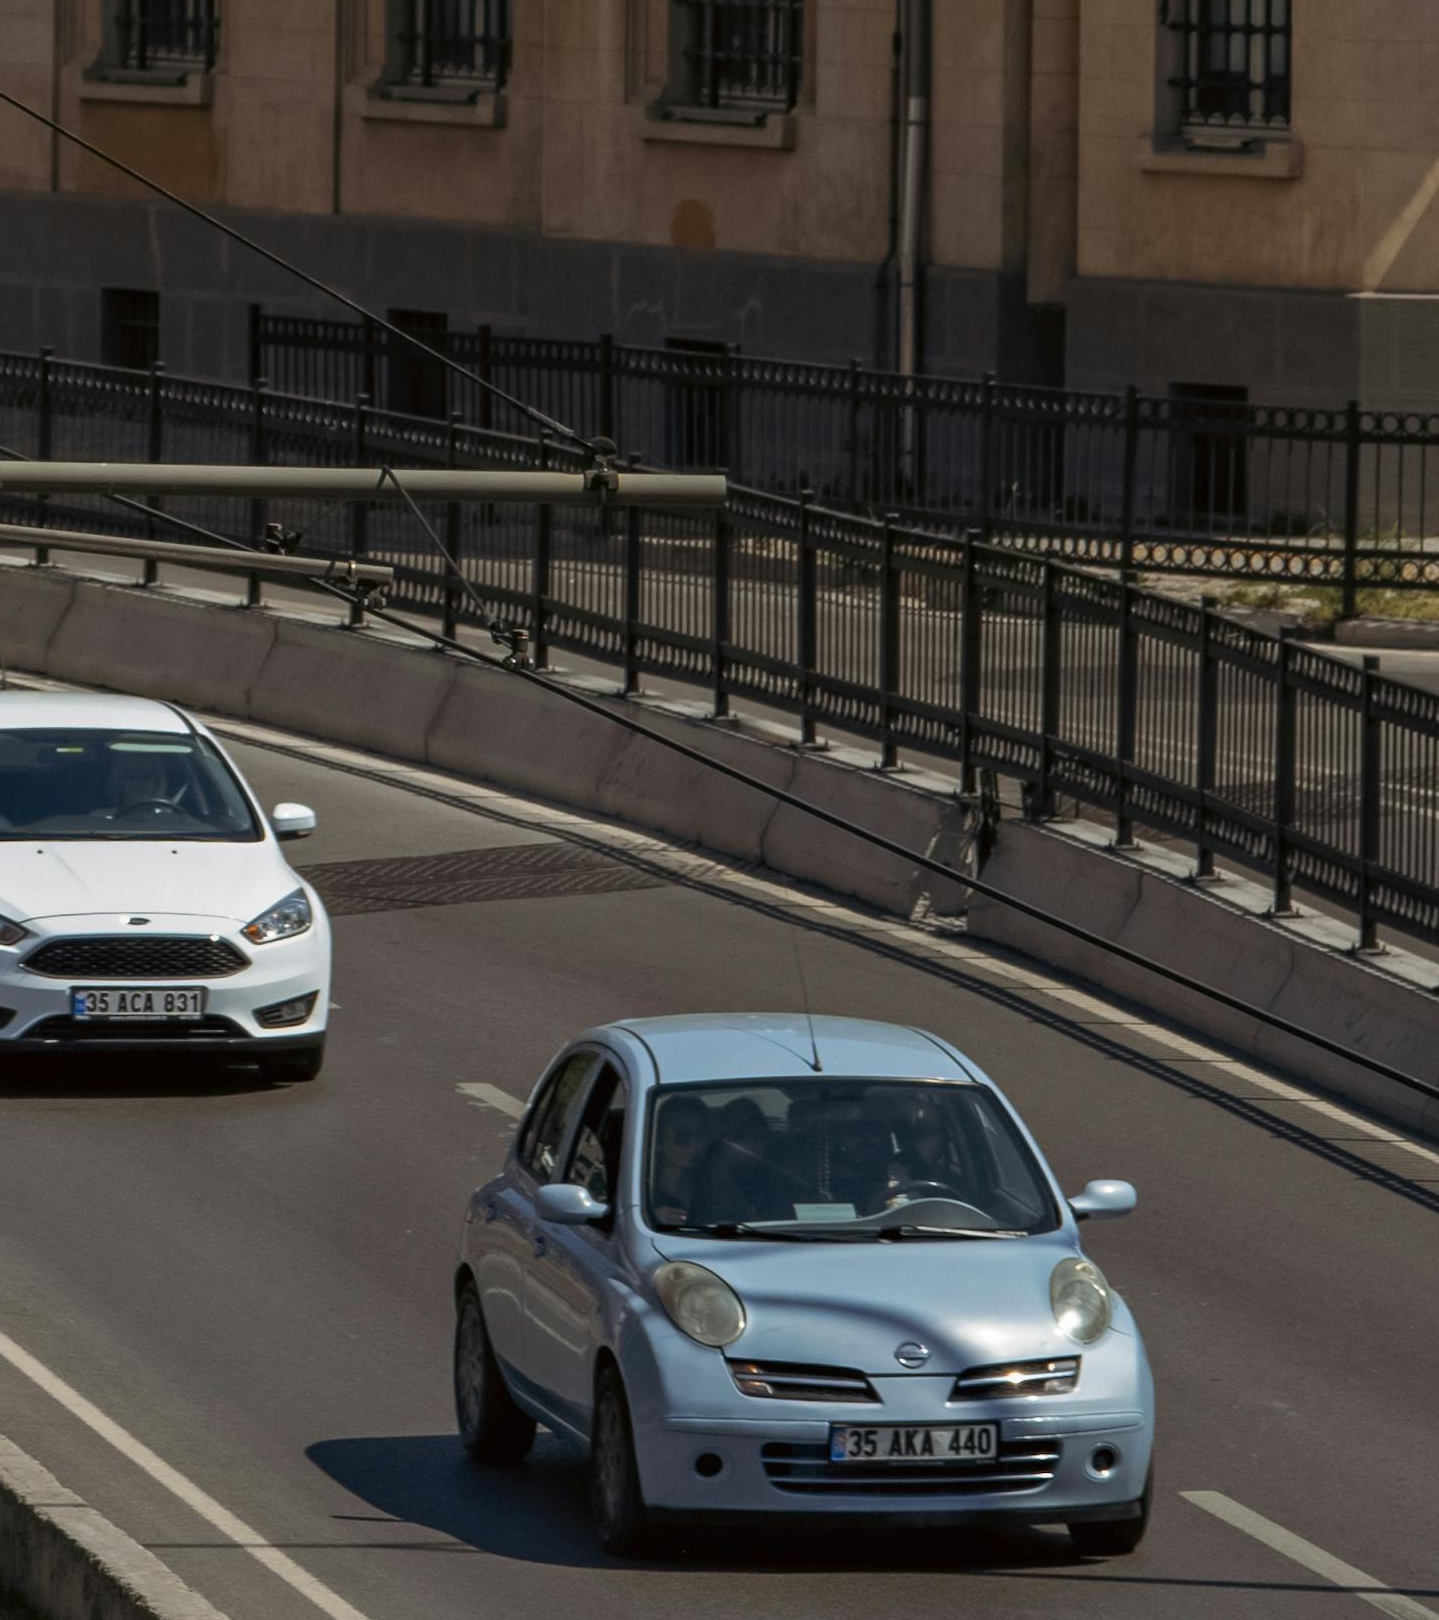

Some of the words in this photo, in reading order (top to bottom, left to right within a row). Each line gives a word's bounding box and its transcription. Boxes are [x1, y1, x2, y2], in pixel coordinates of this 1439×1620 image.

[86, 993, 109, 1013] 35
[117, 993, 154, 1013] ACA
[164, 993, 198, 1013] 831
[849, 1430, 877, 1457] 35
[889, 1430, 935, 1456] AKA
[948, 1428, 991, 1455] 440
